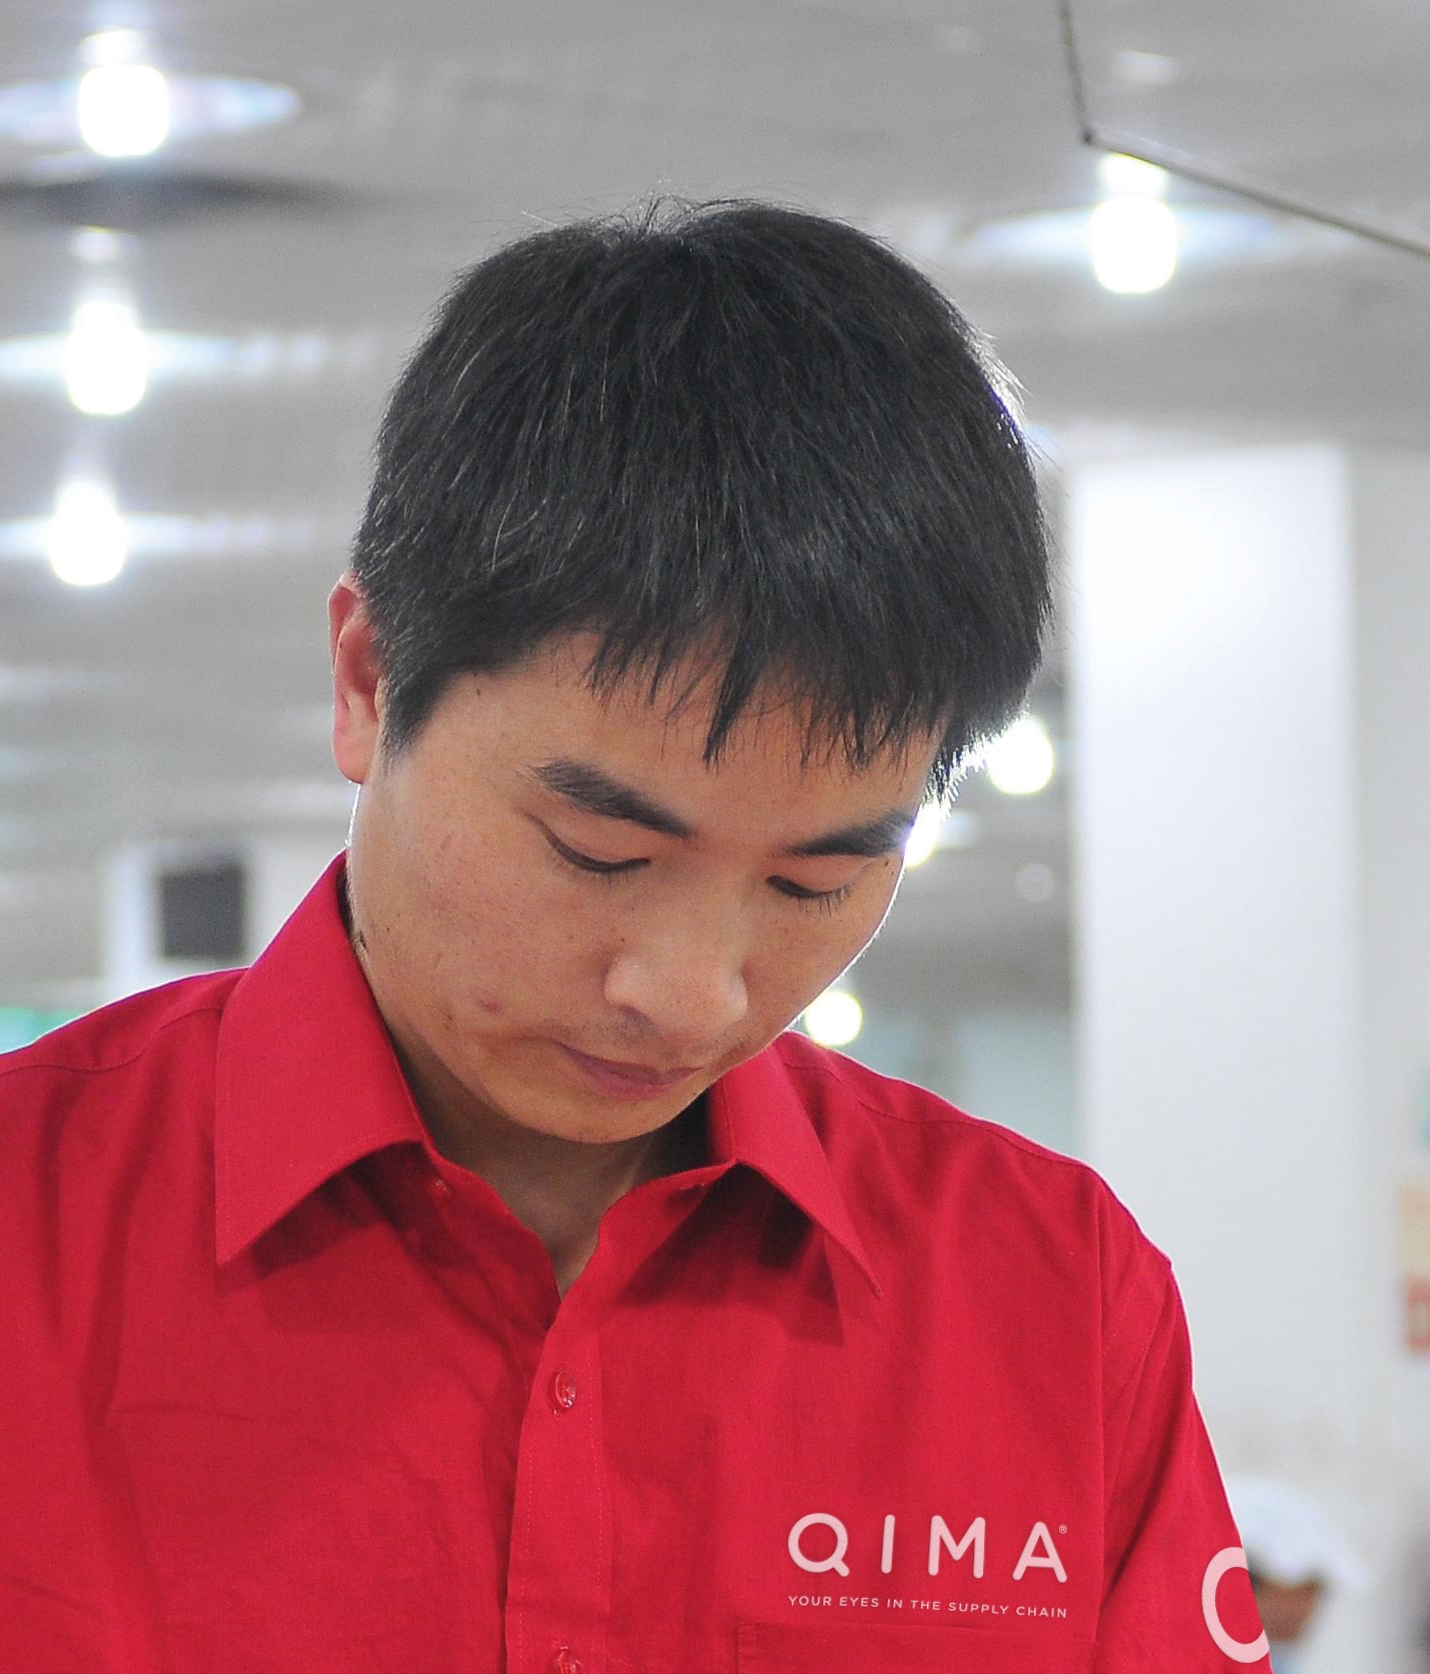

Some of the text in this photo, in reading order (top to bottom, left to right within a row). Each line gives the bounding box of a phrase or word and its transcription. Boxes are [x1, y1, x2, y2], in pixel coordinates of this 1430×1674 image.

[788, 1595, 1067, 1619] YOUR EYES IN THE SUPPLY CHAIN
